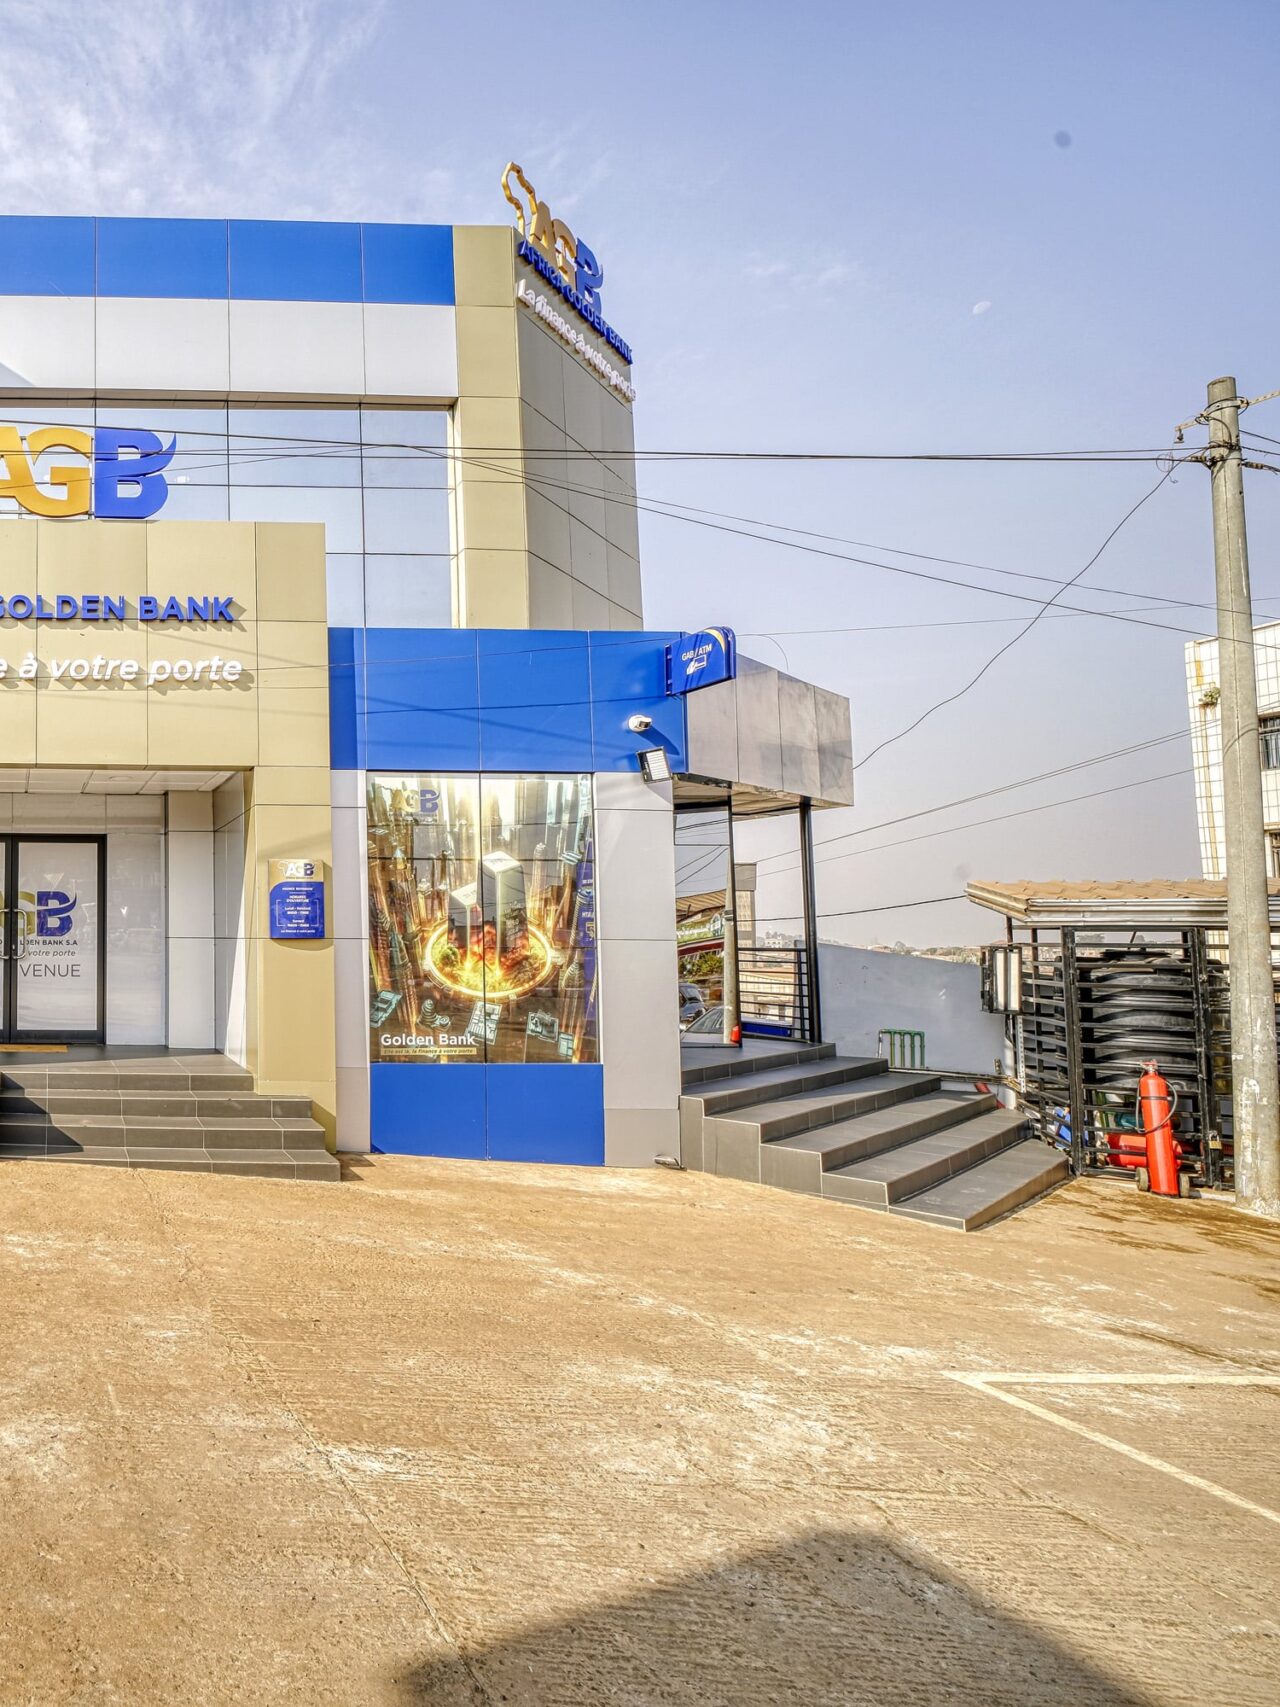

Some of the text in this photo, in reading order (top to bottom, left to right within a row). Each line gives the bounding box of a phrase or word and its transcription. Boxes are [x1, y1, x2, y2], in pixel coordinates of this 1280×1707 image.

[528, 200, 604, 315] AGB
[518, 239, 633, 365] AFRICA GOLDEN BANK
[517, 279, 636, 401] La finance à votre porte
[138, 595, 235, 622] BANK
[19, 652, 39, 679] à
[51, 654, 139, 681] votre
[146, 655, 243, 686] porte
[285, 863, 317, 876] AGB
[52, 949, 76, 957] porte
[381, 1034, 476, 1046] Golden Bank
